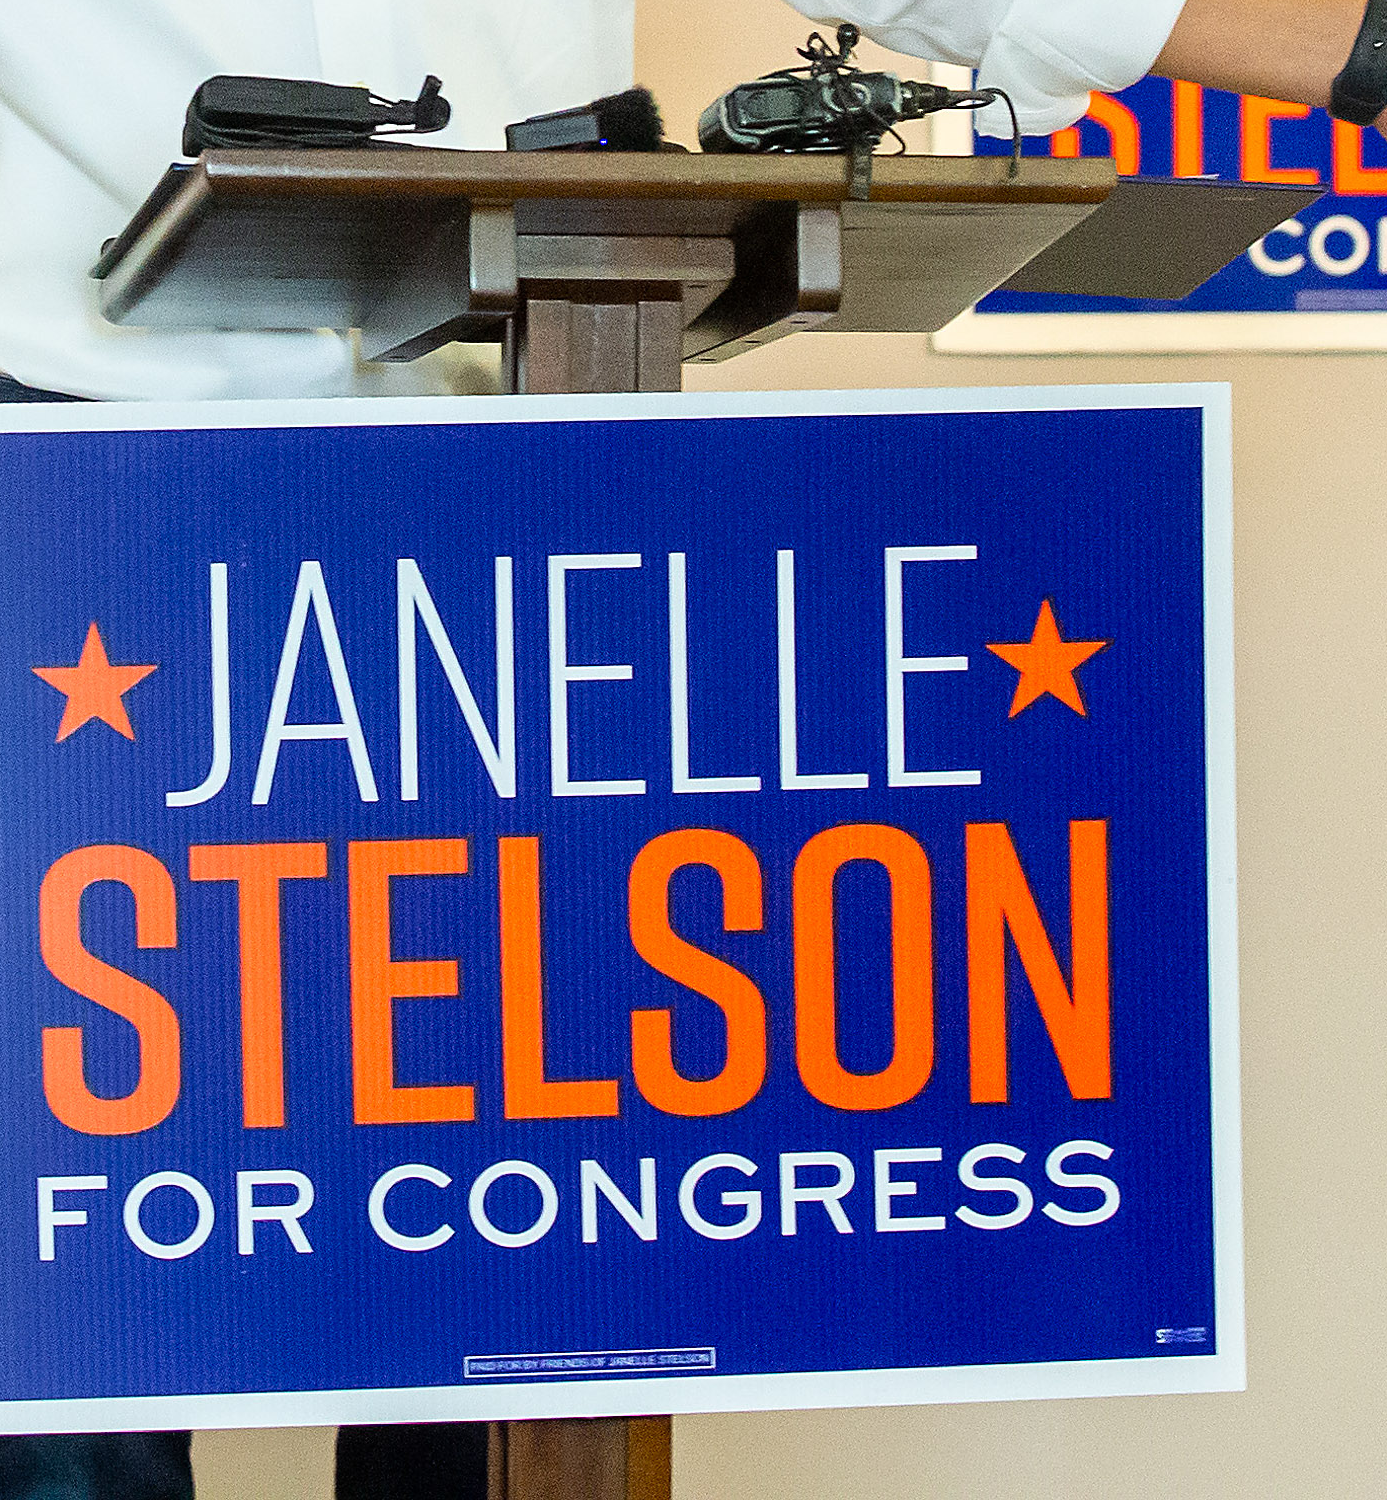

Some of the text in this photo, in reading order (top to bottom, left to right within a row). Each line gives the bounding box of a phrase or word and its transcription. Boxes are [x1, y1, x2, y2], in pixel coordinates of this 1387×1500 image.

[166, 545, 982, 808] JANELLE
[38, 818, 1112, 1137] STELSON
[36, 1139, 1122, 1262] FOR CONGRESS
